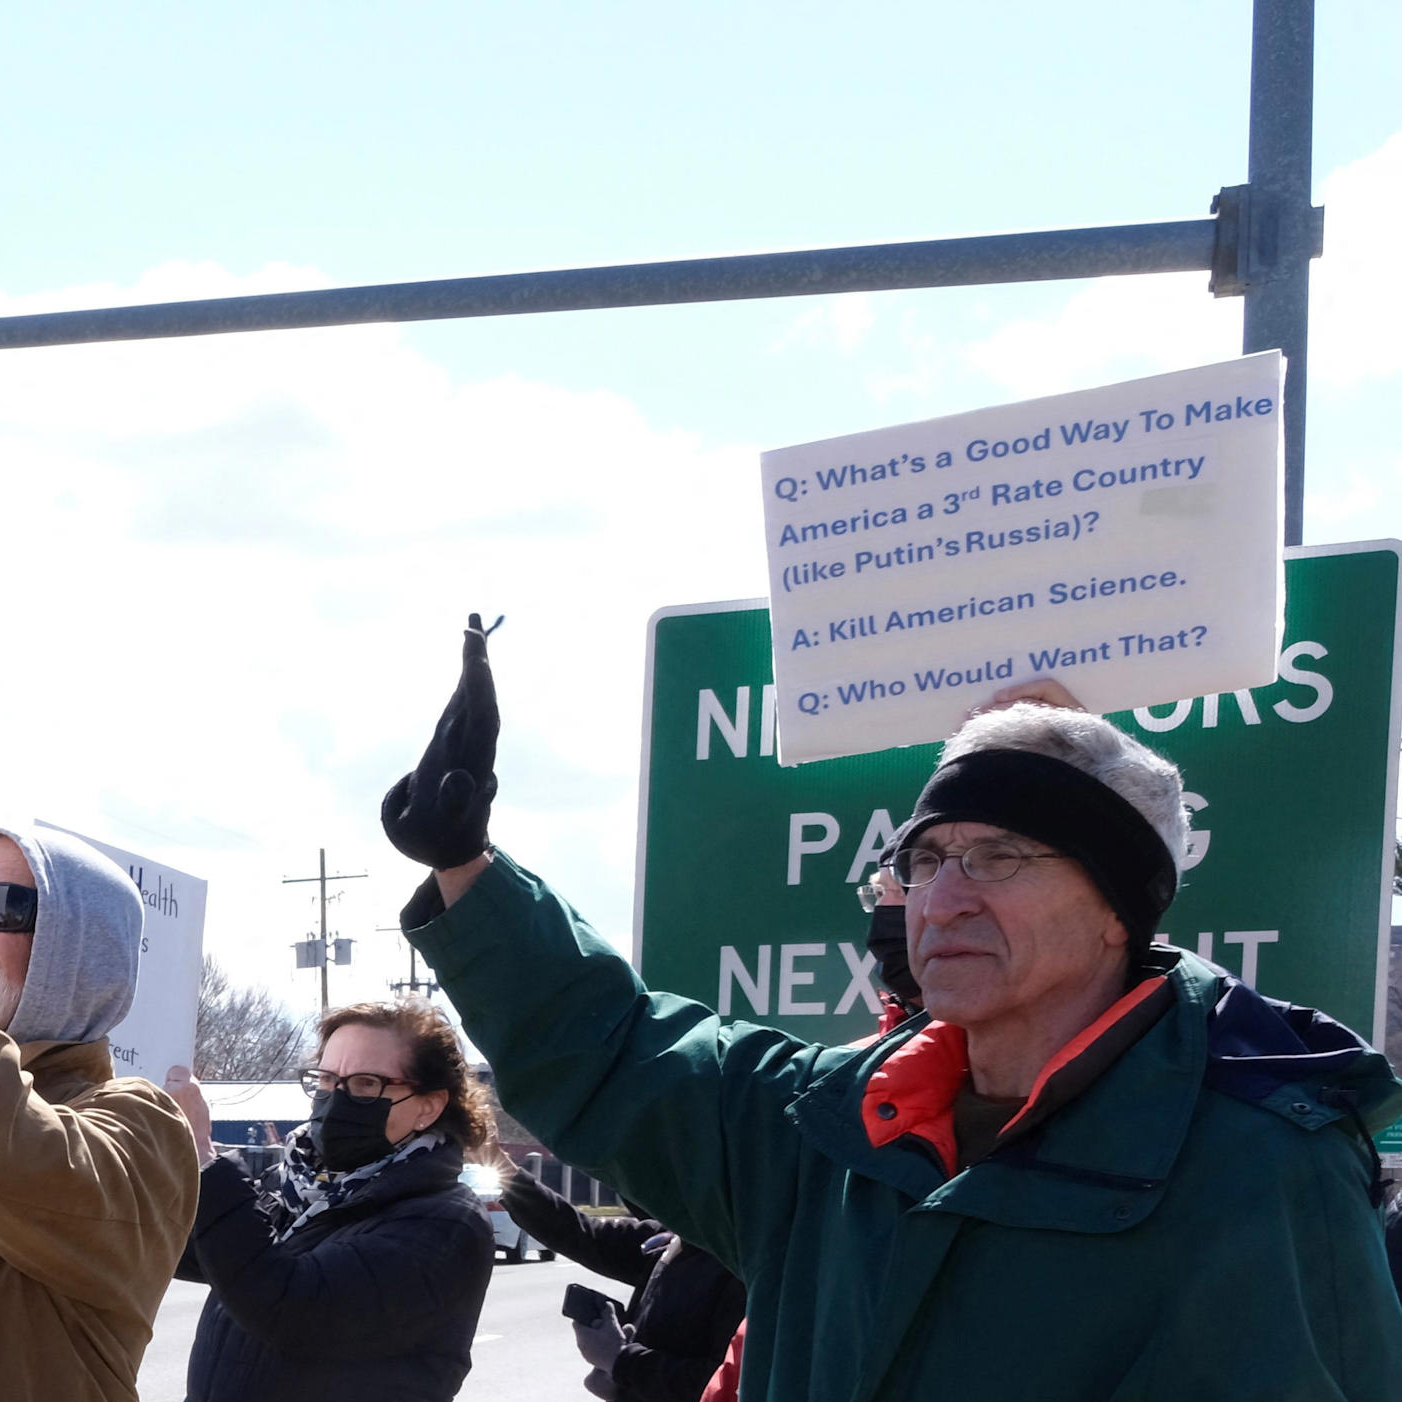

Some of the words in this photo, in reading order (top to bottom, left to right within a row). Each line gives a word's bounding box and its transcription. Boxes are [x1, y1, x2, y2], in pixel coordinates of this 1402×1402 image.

[774, 477, 808, 503] Q:
[816, 453, 927, 491] What’s
[935, 451, 953, 469] a
[966, 428, 1051, 462] Good
[1059, 419, 1130, 446] Way
[1139, 409, 1175, 433] To
[1185, 396, 1273, 427] Make
[779, 507, 908, 547] America
[916, 502, 934, 520] a
[942, 485, 981, 515] 3rd
[991, 479, 1063, 506] Rate
[1072, 456, 1205, 492] Country
[782, 560, 846, 593] (like
[854, 537, 961, 573] Putin’s
[965, 511, 1100, 553] Russia)?
[791, 628, 820, 651] A:
[829, 615, 878, 643] Kill
[884, 591, 1035, 632] American
[1049, 570, 1186, 605] Science.
[797, 691, 829, 716] Q:
[837, 679, 906, 705] Who
[913, 658, 1014, 692] Would
[1028, 641, 1111, 672] Want
[1118, 625, 1208, 657] That?
[717, 942, 886, 1018] NEX
